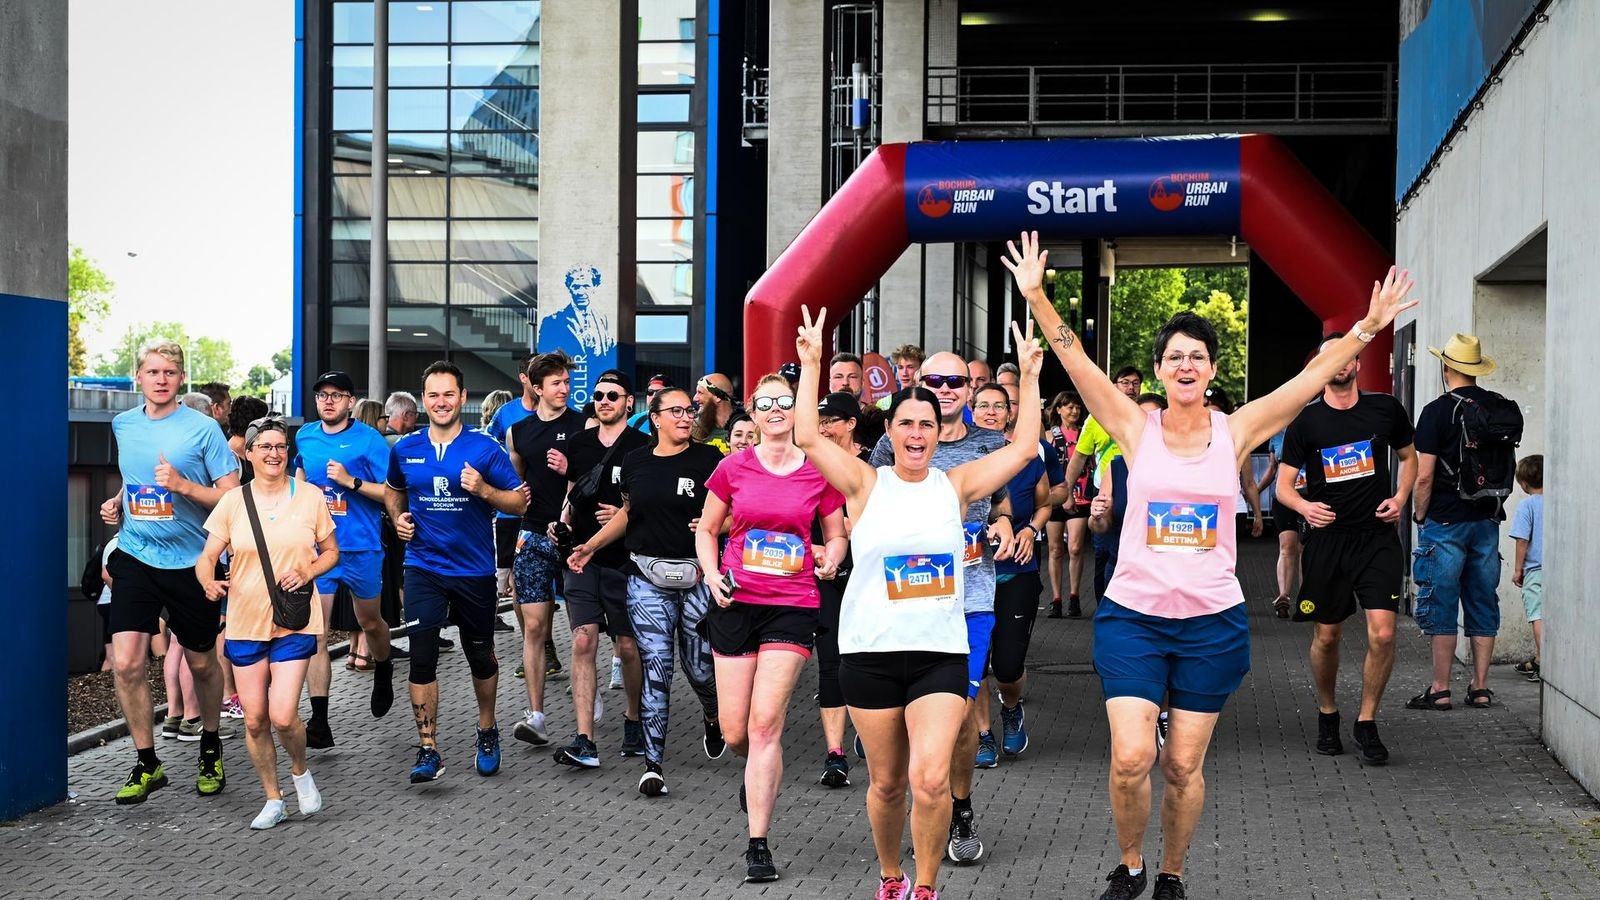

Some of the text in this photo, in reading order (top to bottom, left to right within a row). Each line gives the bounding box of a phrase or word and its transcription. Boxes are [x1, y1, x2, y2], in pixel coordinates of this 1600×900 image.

[1171, 173, 1210, 183] BOCHUM
[938, 180, 977, 191] BOCHUM
[1186, 181, 1228, 195] URBAN
[953, 189, 995, 202] URBAN
[1027, 179, 1118, 215] Start
[1185, 194, 1210, 207] RUN
[952, 202, 977, 214] RUN
[1340, 458, 1357, 467] 1909
[140, 499, 155, 507] 1471
[1171, 523, 1193, 533] 1928
[1163, 536, 1199, 545] BETTINA
[764, 548, 784, 558] 2035
[909, 574, 930, 584] 2471
